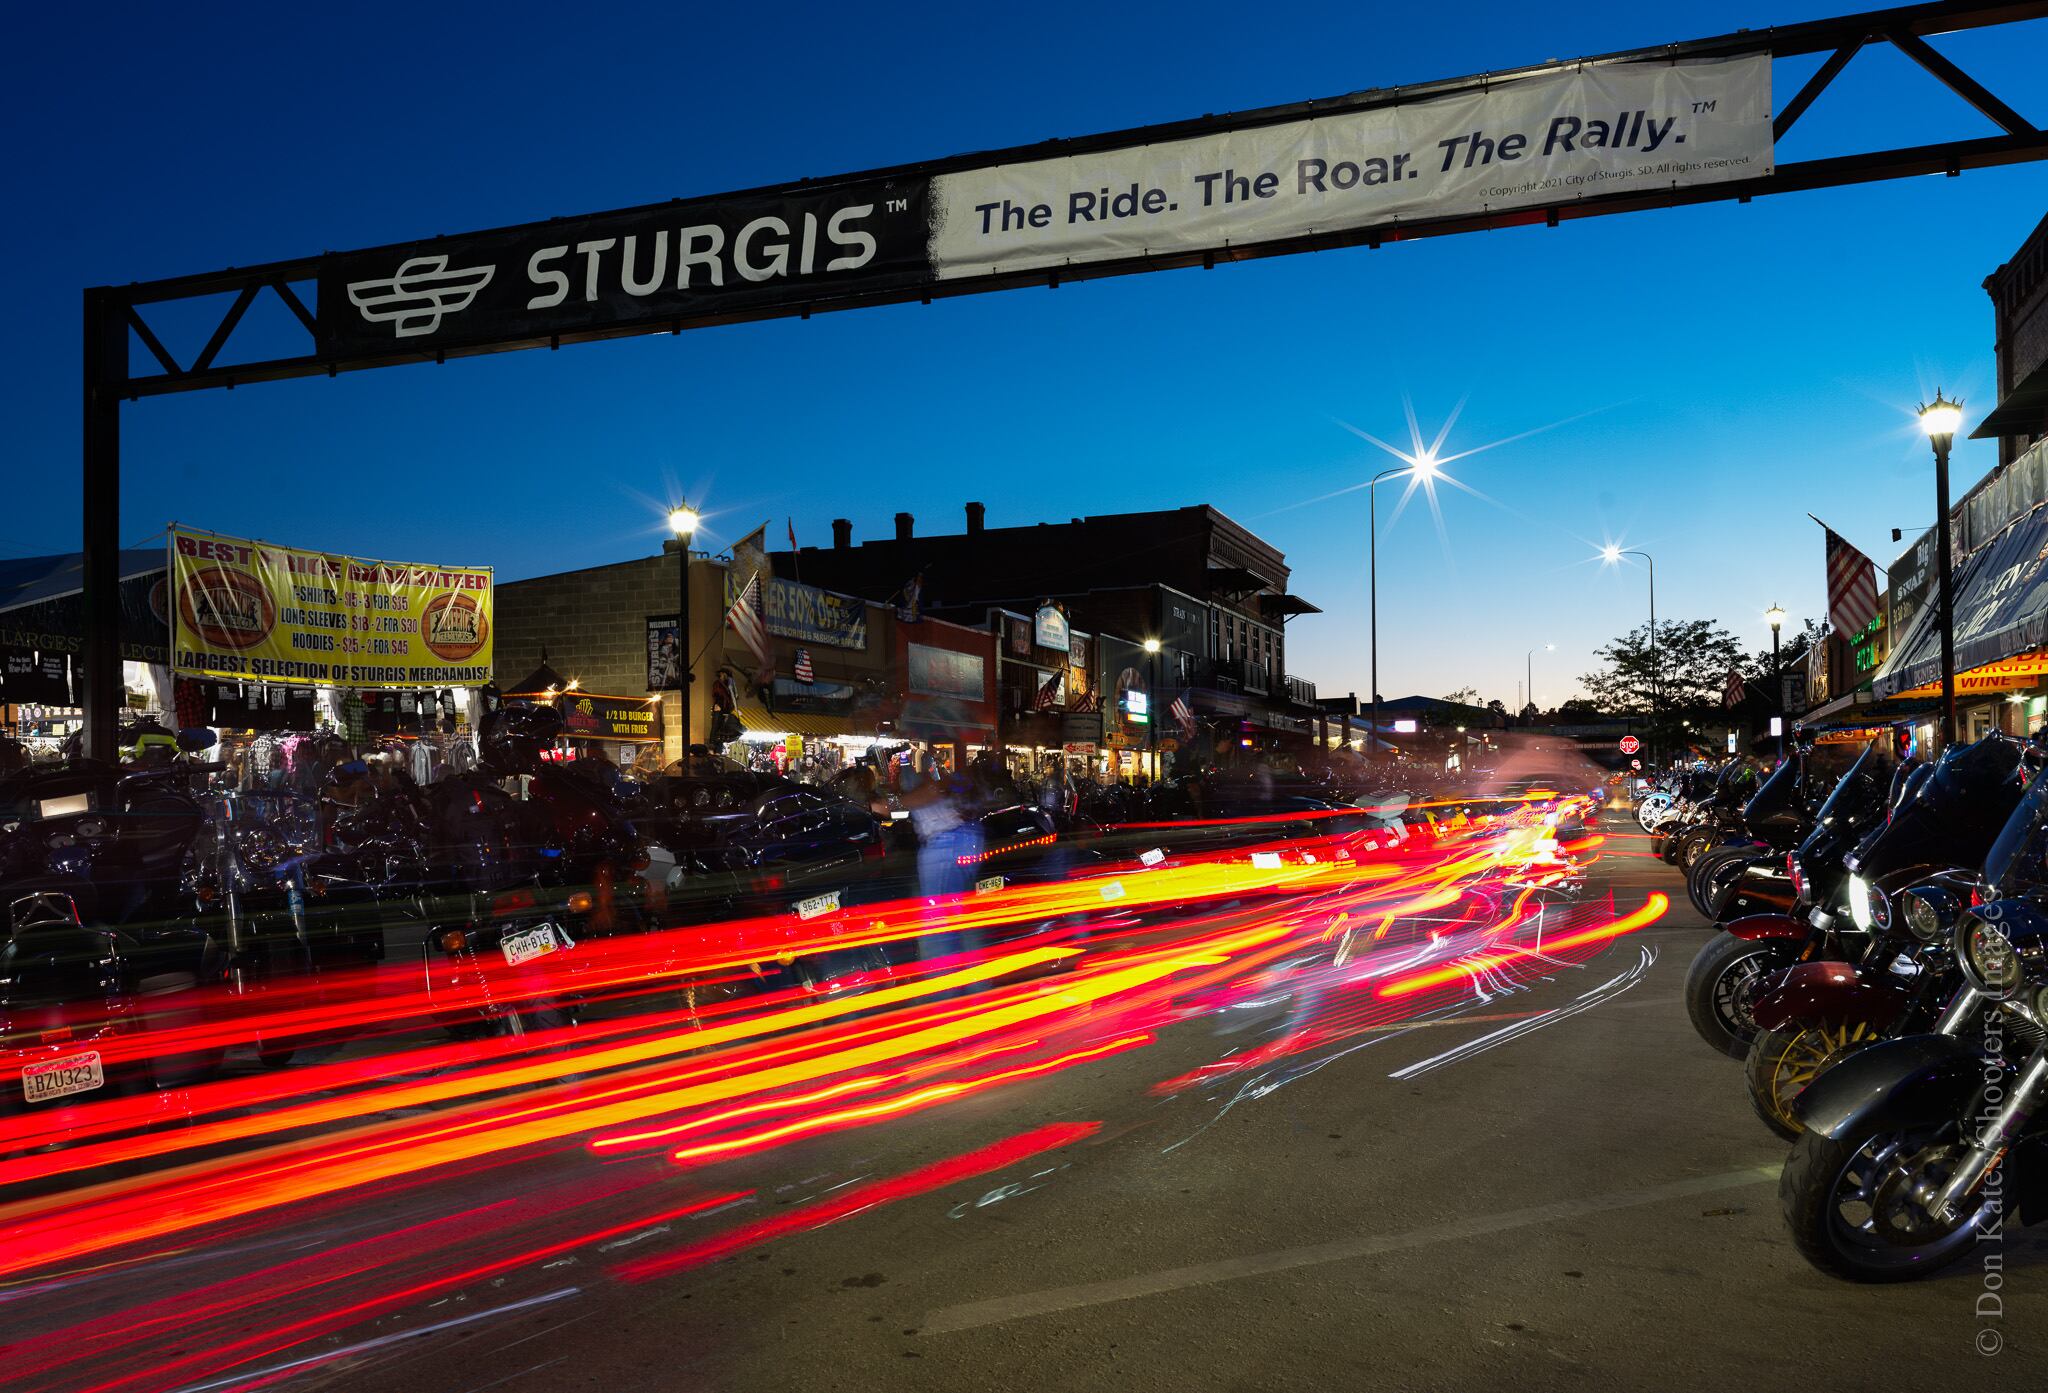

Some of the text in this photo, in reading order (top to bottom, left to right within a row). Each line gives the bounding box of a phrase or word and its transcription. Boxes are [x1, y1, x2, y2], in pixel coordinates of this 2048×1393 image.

[975, 199, 1052, 235] The
[1067, 183, 1179, 224] Ride.
[1194, 169, 1280, 207] The
[1297, 152, 1418, 195] Roar.
[1437, 130, 1527, 173] The
[1543, 110, 1687, 156] Rally.
[1489, 182, 1537, 199] Copyright
[1539, 178, 1563, 190] 2021
[1565, 175, 1585, 188] City
[1584, 173, 1597, 183] of
[1656, 163, 1670, 173] All
[1672, 162, 1702, 175] rights
[526, 203, 877, 310] STURGIS
[175, 535, 253, 566] BEST
[292, 585, 337, 605] T-SHIRTS
[373, 594, 390, 610] FOR
[281, 607, 306, 625] LONG
[307, 609, 347, 629] SLEEVES
[375, 617, 382, 632] 2
[383, 617, 399, 633] FOR
[400, 618, 418, 633] $30
[0, 628, 84, 653] LARGES
[292, 632, 334, 651] HOODIES
[366, 639, 372, 654] 2
[374, 639, 389, 655] FOR
[391, 639, 408, 655] $45
[177, 651, 489, 682] LARGEST SELECTION OF STURGIS MERCHANDISE
[649, 629, 661, 686] STURGIS
[1961, 675, 2011, 688] WINE
[612, 723, 648, 734] WITH FRIES
[629, 711, 654, 722] BURGER
[1621, 740, 1638, 750] STOP
[34, 1064, 93, 1093] BZU323
